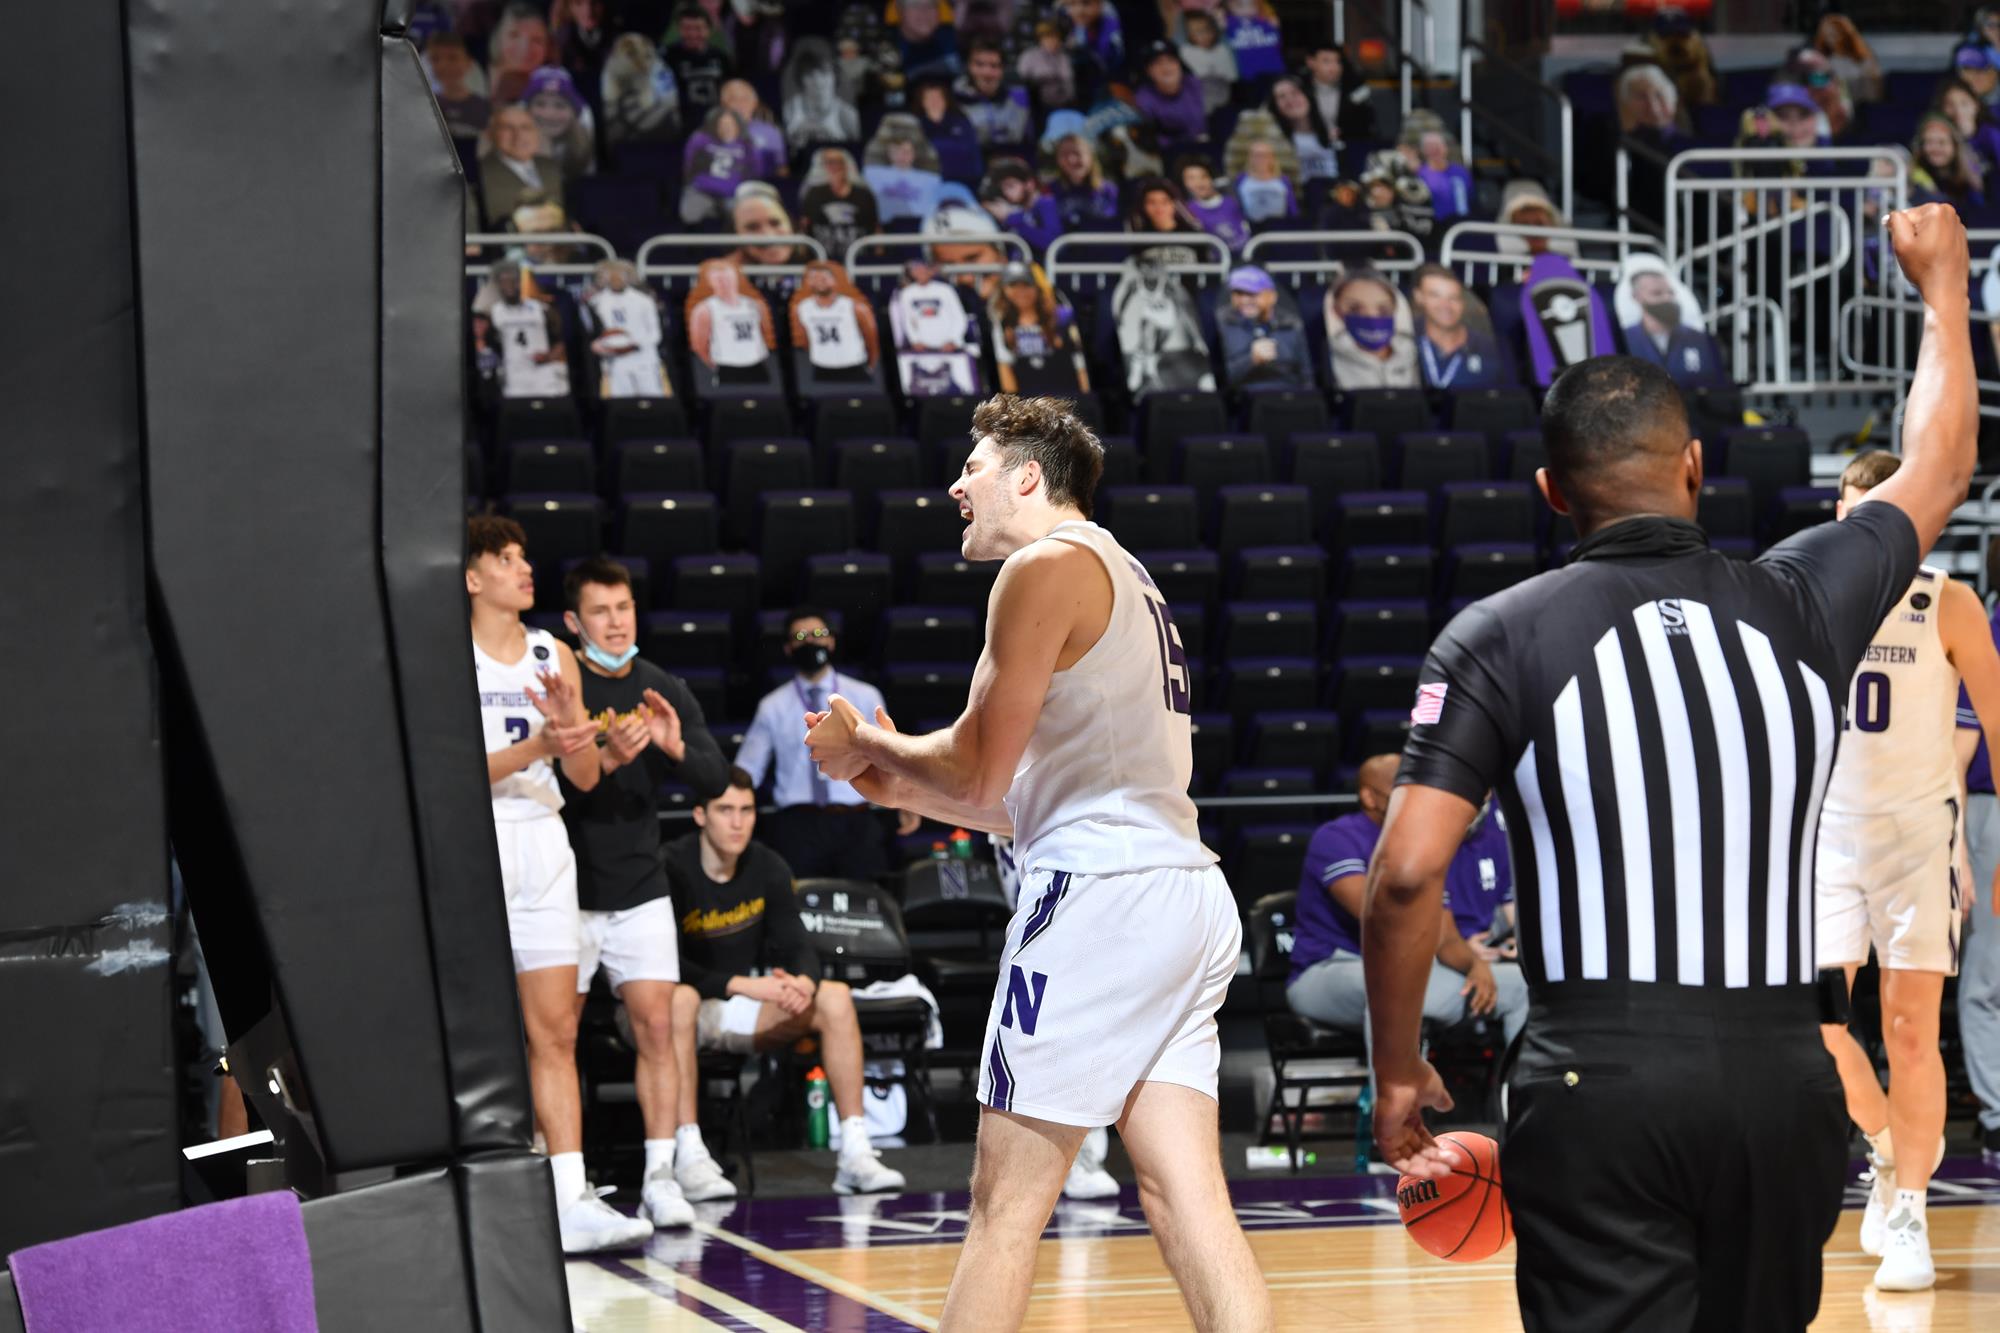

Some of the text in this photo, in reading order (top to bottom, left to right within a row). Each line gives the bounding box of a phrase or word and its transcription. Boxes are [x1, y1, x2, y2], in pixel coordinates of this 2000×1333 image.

[1143, 592, 1191, 715] 15
[1861, 645, 1917, 664] ESTERN
[1842, 671, 1891, 733] 0
[1000, 964, 1049, 1036] N
